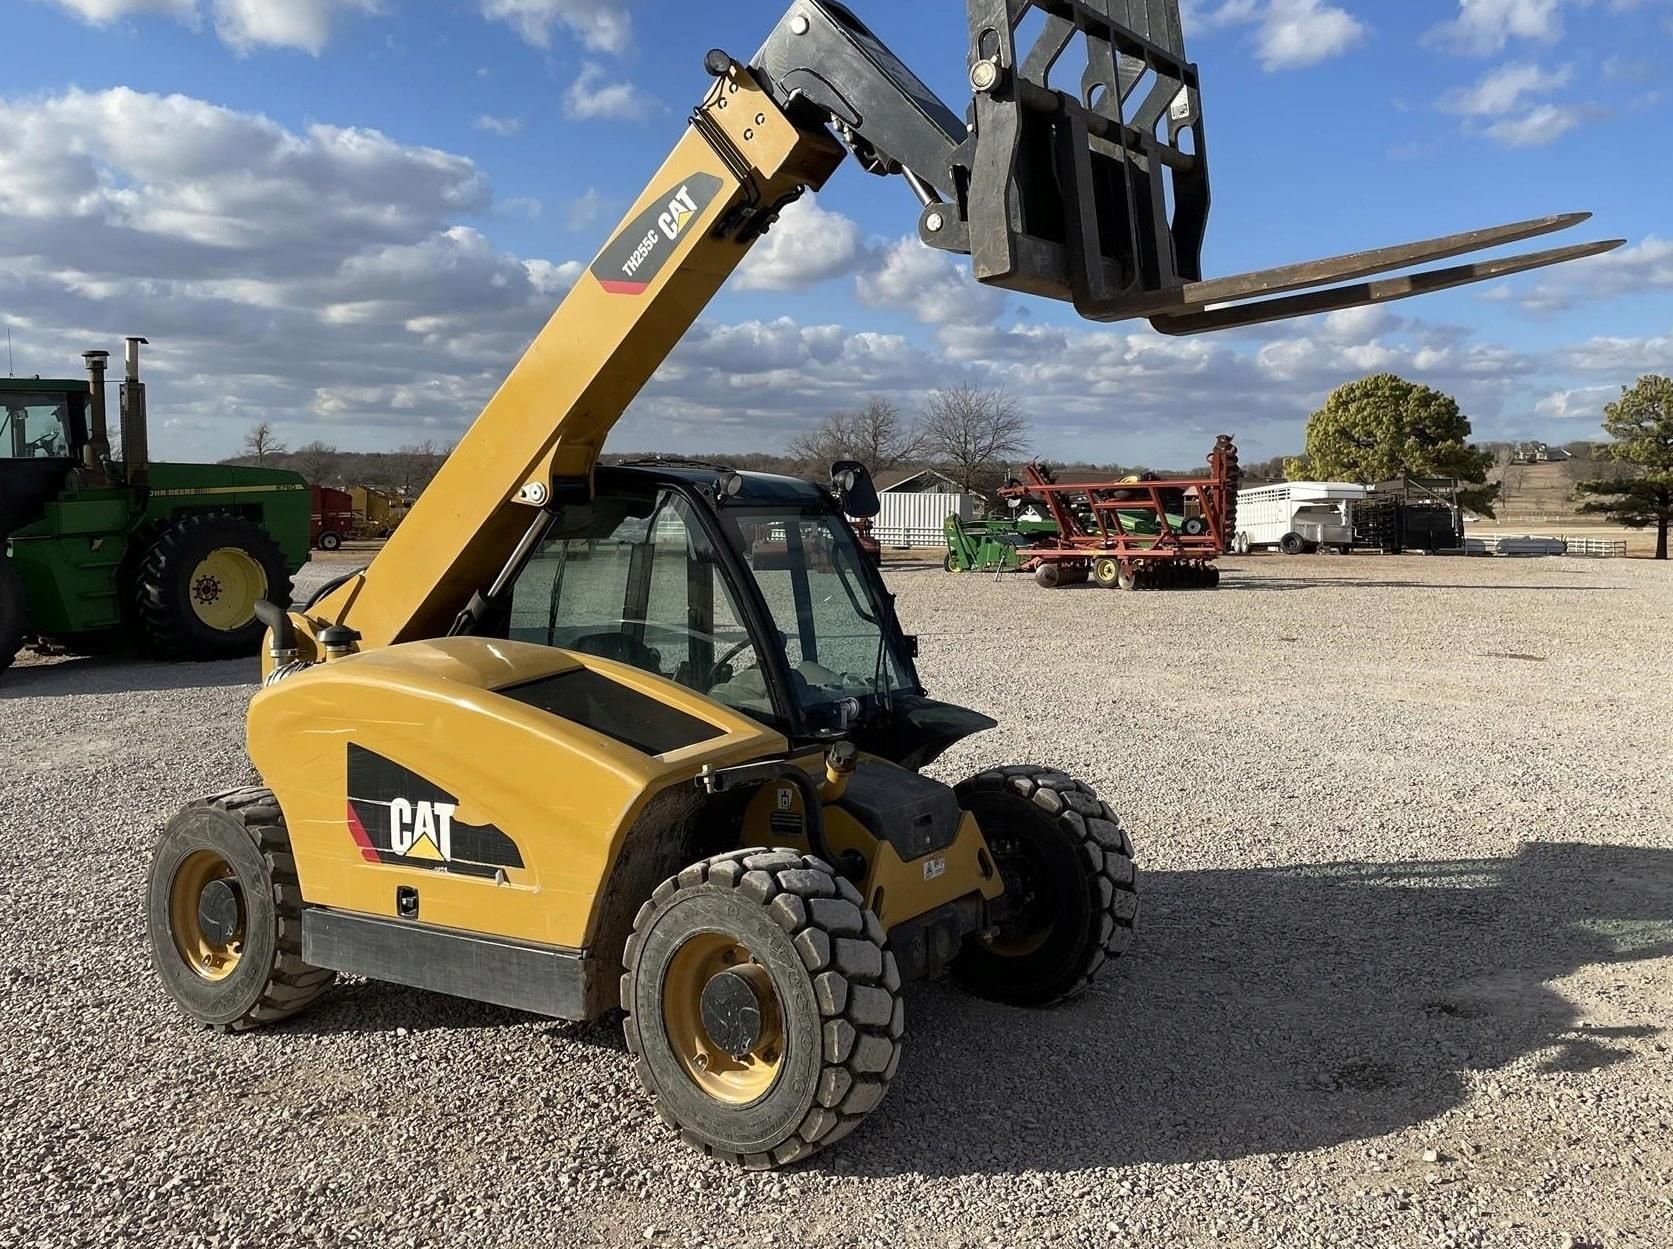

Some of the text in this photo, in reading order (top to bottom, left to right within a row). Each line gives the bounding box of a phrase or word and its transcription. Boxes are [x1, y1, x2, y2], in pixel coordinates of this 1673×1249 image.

[621, 185, 698, 277] TH255C CAT
[390, 797, 457, 862] CAT
